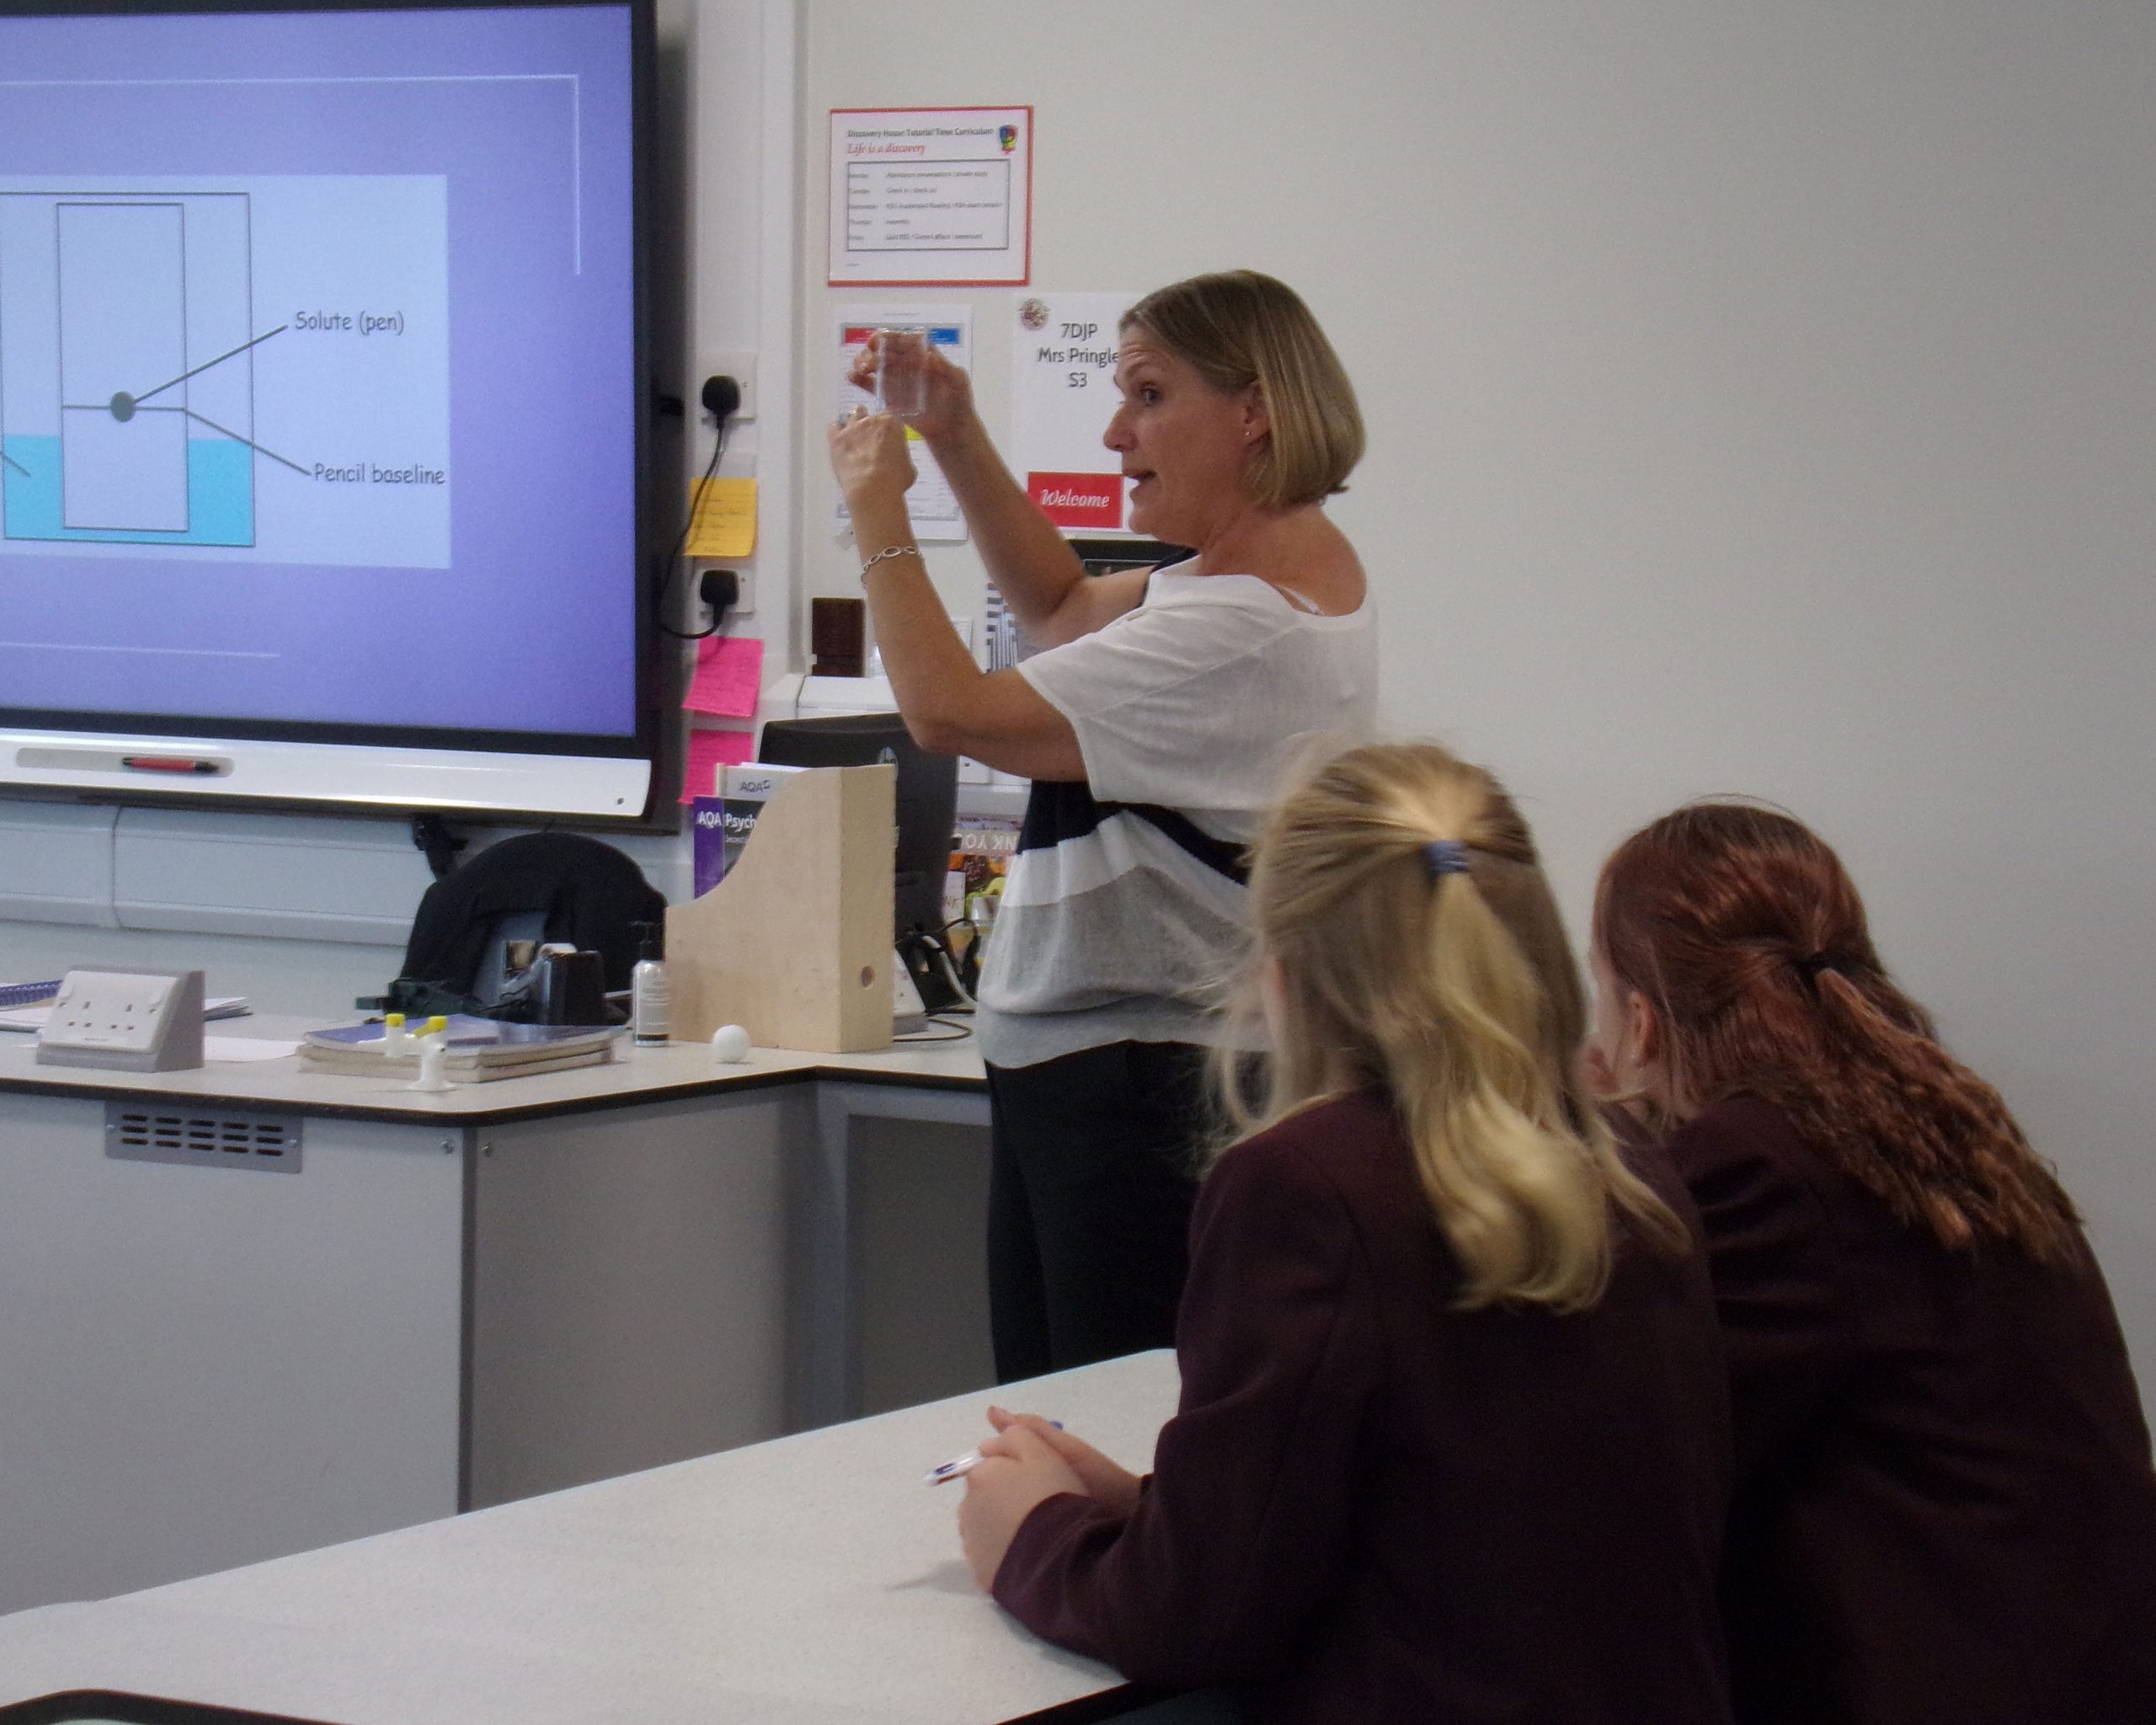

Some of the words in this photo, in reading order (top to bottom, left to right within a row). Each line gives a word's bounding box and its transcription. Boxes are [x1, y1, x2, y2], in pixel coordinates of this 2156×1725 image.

[295, 309, 353, 330] Solute
[359, 310, 405, 336] (pen)
[1060, 323, 1098, 342] 7DJP
[1038, 347, 1065, 363] Mrs
[1069, 347, 1119, 368] Pringle
[1069, 371, 1088, 387] S3
[314, 462, 366, 483] Pencil
[372, 463, 446, 484] baseline
[1040, 488, 1111, 507] Welcome
[696, 811, 723, 829] AQA
